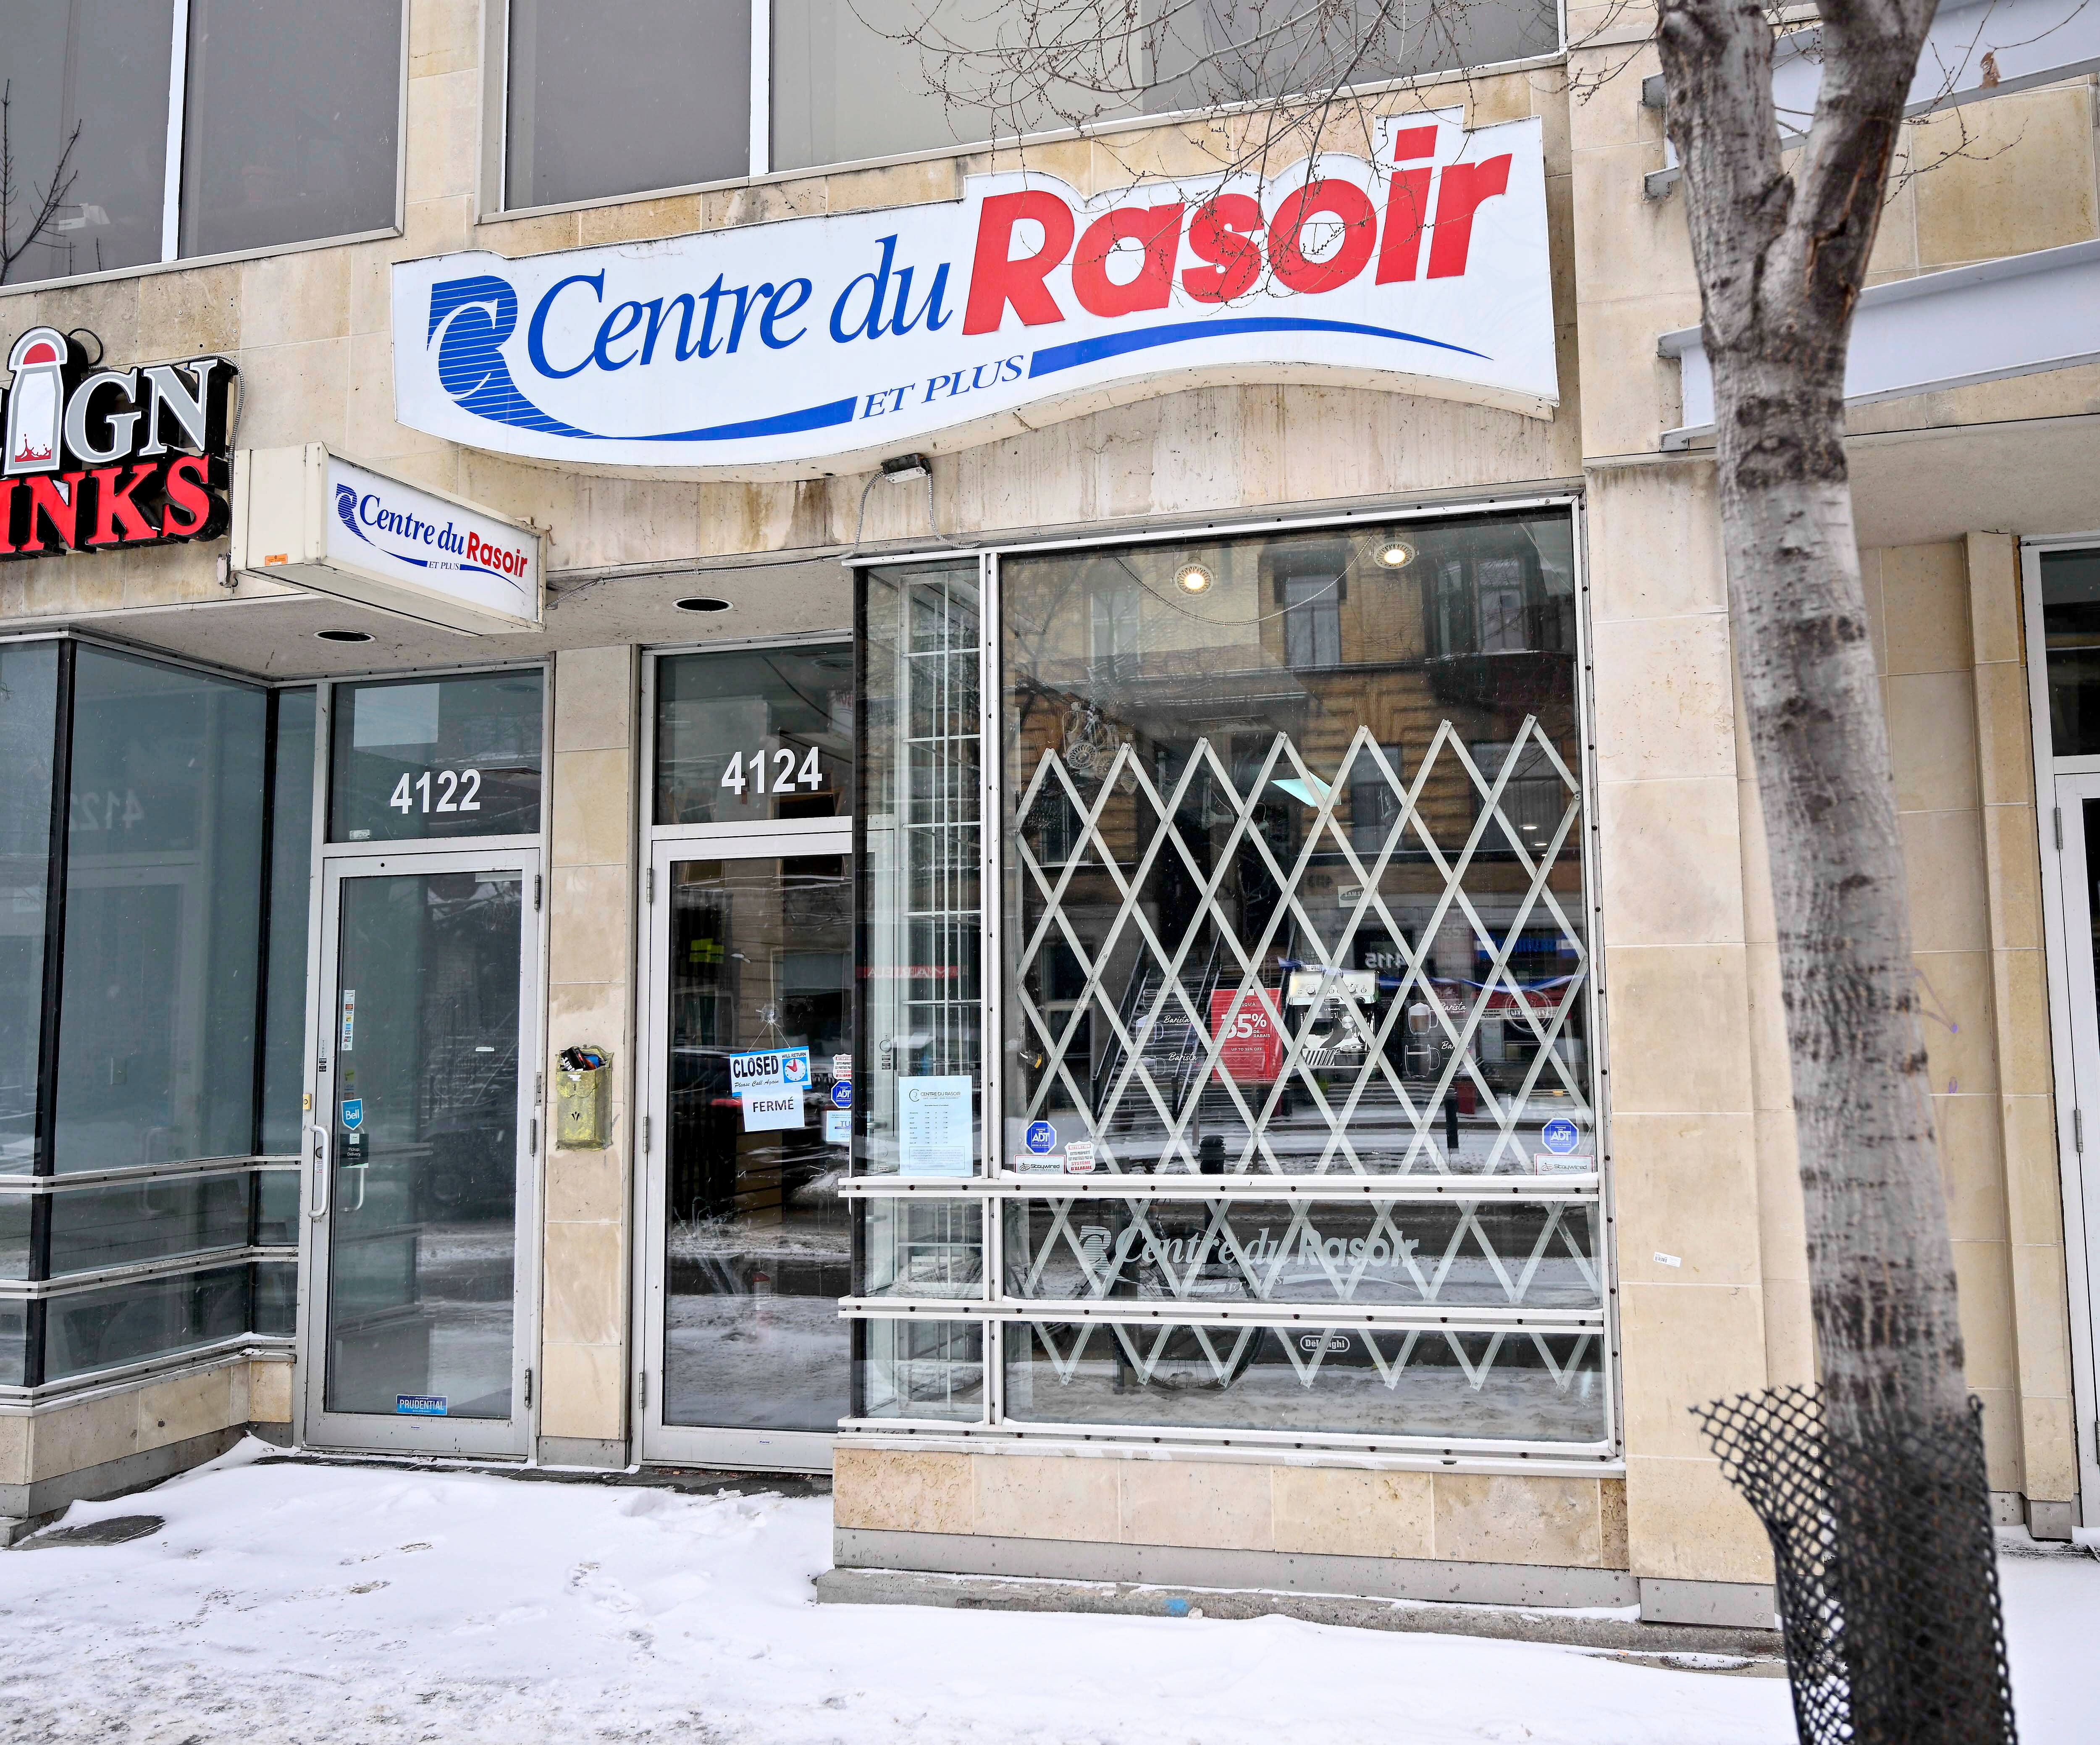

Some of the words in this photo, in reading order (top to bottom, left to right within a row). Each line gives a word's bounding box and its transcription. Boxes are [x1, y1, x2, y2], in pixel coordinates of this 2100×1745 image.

[528, 268, 812, 379] Centre
[829, 234, 954, 343] du
[963, 125, 1512, 335] Rasoir
[859, 383, 916, 420] ET
[922, 355, 1024, 403] PLUS
[0, 326, 218, 475] IGN
[360, 494, 435, 545] Centre
[438, 522, 464, 555] du
[466, 531, 528, 577] Rasoir
[441, 562, 460, 571] PLUS
[721, 746, 823, 795] 4124
[390, 769, 481, 814] 4122
[1164, 1015, 1190, 1023] Barista
[1168, 1052, 1197, 1061] Barista
[733, 1055, 779, 1078] CLOSED
[836, 1090, 851, 1098] ADT
[753, 1096, 794, 1113] FERMÉ
[346, 1109, 360, 1120] Bell
[1032, 1132, 1050, 1142] ADT
[1550, 1130, 1571, 1141] ADT
[1115, 1227, 1235, 1264] Centre
[1249, 1228, 1290, 1265] du
[1297, 1229, 1420, 1267] Rasoir
[399, 1399, 444, 1410] PRUDENTIAL
